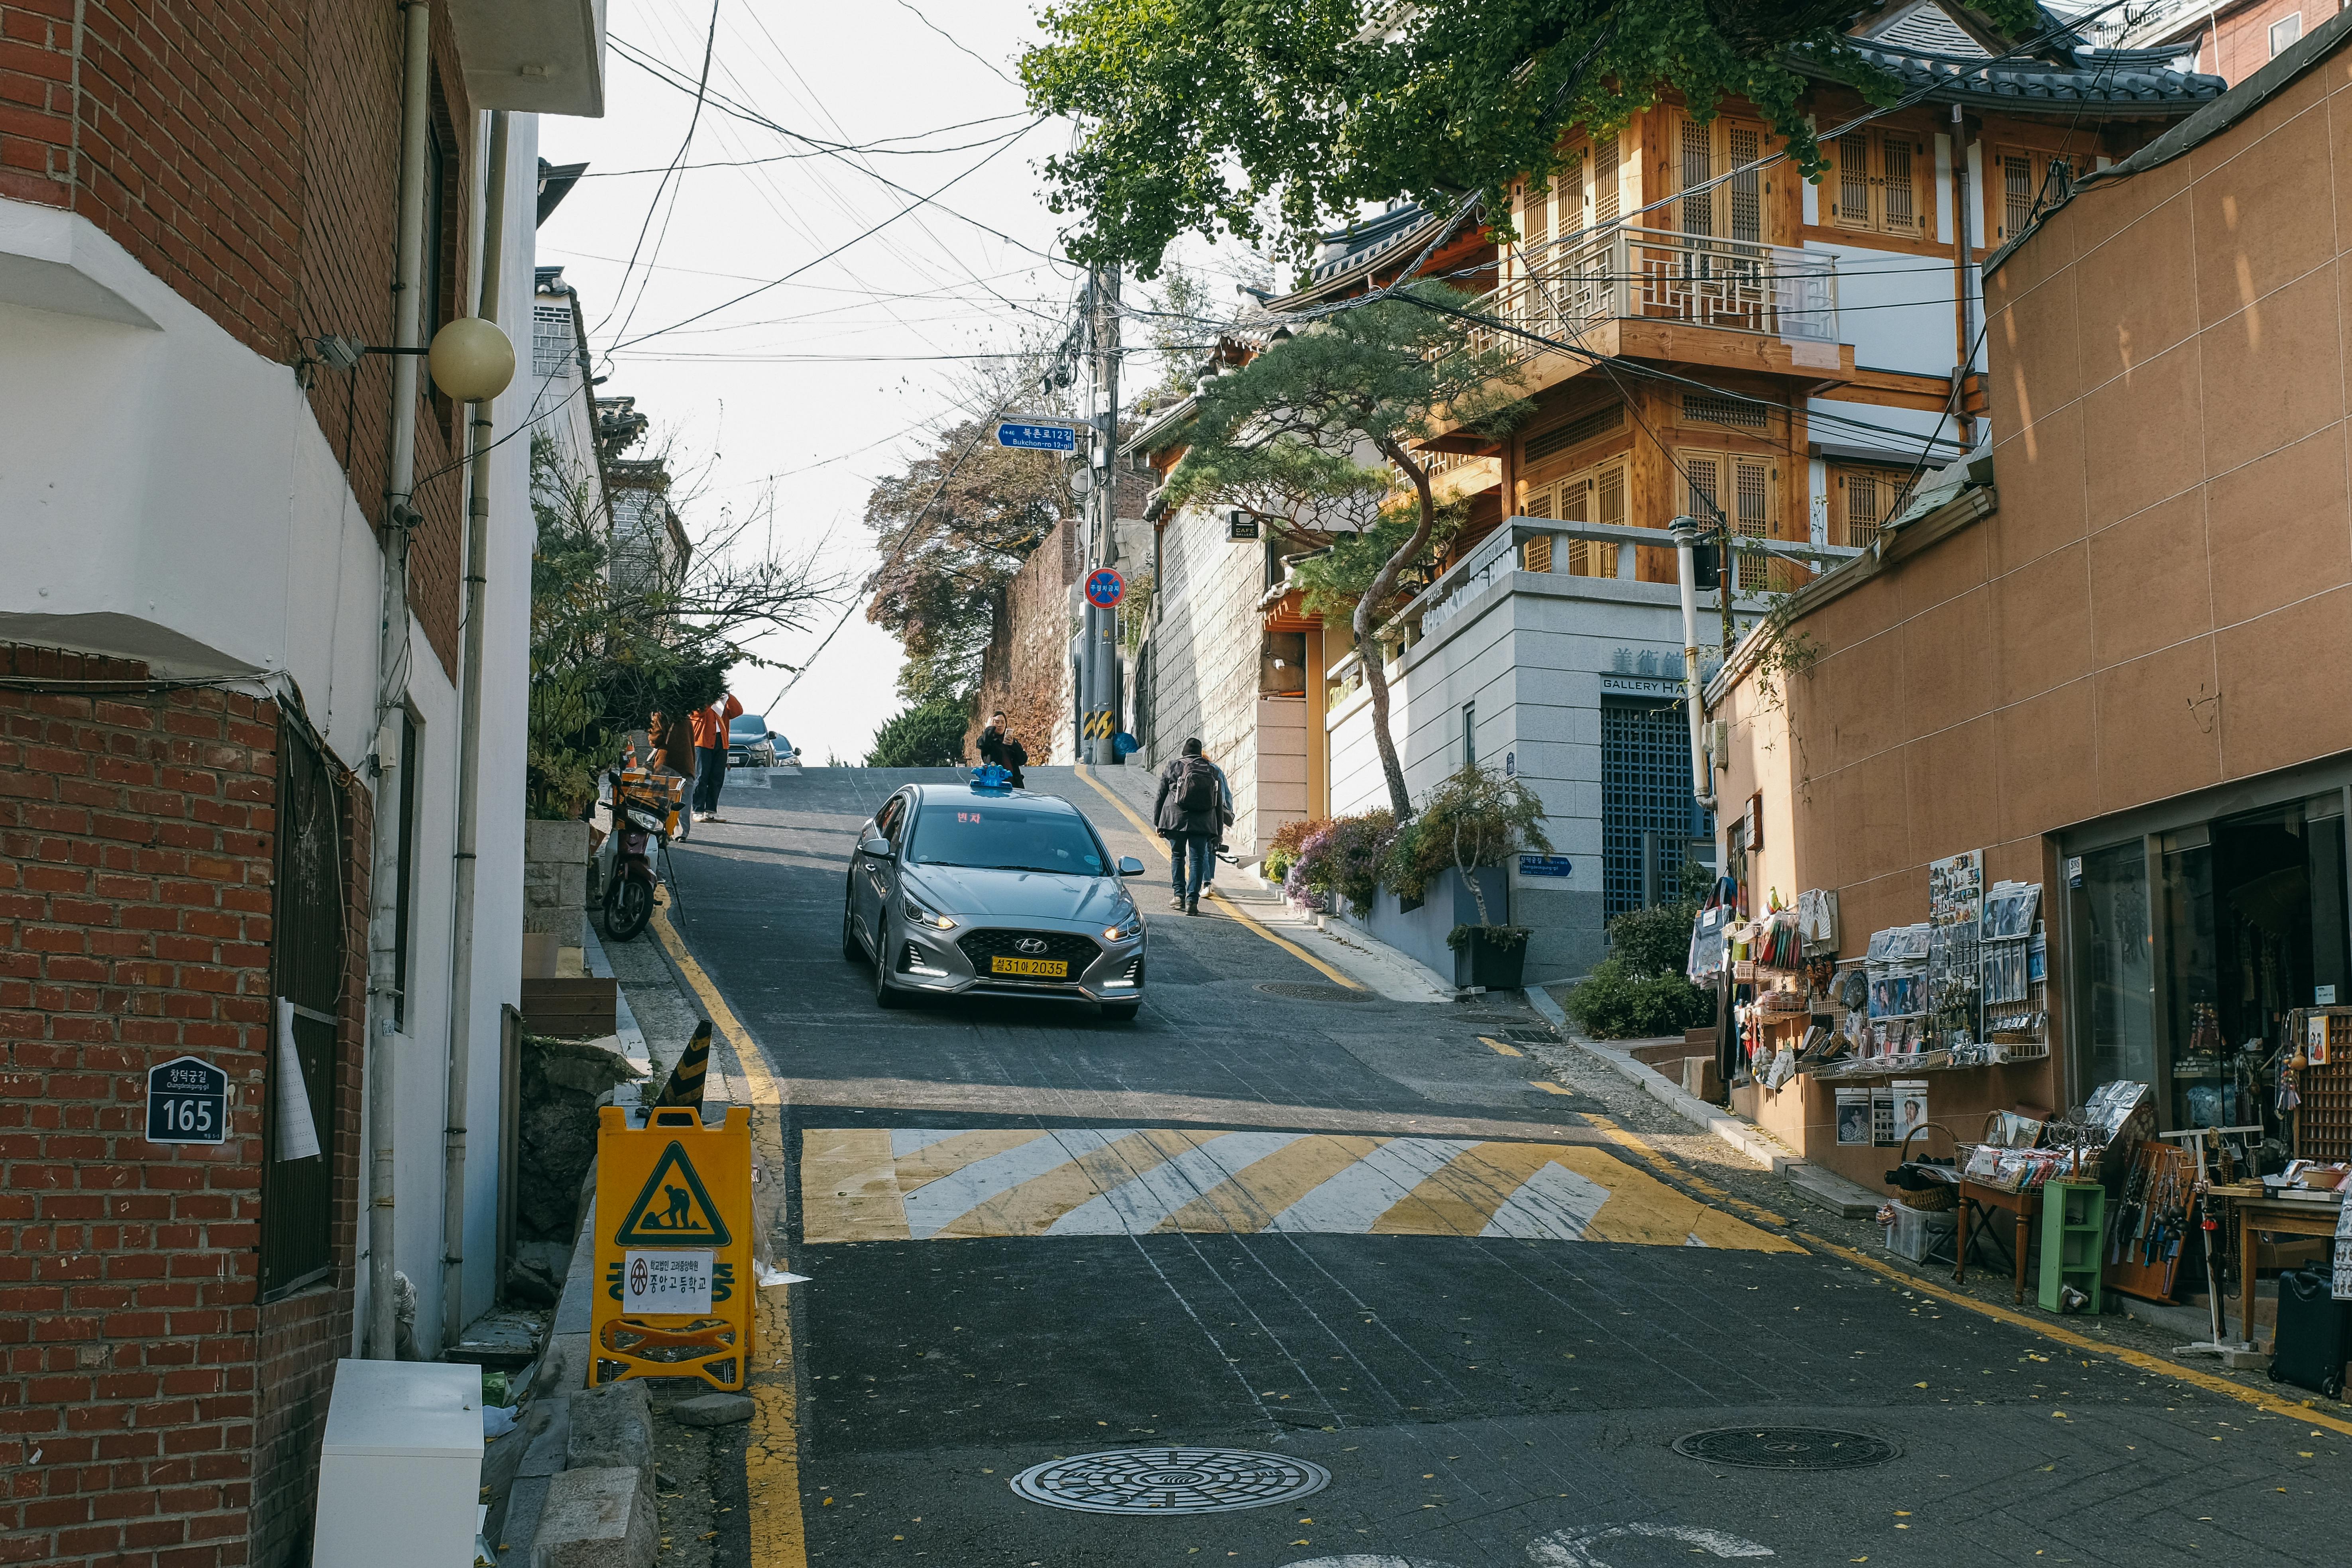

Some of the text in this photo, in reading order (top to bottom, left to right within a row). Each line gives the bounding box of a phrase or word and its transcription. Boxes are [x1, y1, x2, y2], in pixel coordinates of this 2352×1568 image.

[1022, 428, 1072, 441] 북촌로12길
[1013, 439, 1072, 450] Bukchon-ro 12-gil
[1603, 679, 1686, 694] GALLERY HA
[1005, 960, 1028, 972] 31아
[1032, 962, 1063, 975] 2035
[171, 1069, 206, 1083] 창덕궁길
[163, 1100, 212, 1131] 165
[650, 1260, 699, 1271] 학교법인 고려중앙학원
[650, 1275, 706, 1294] 중앙고등학교
